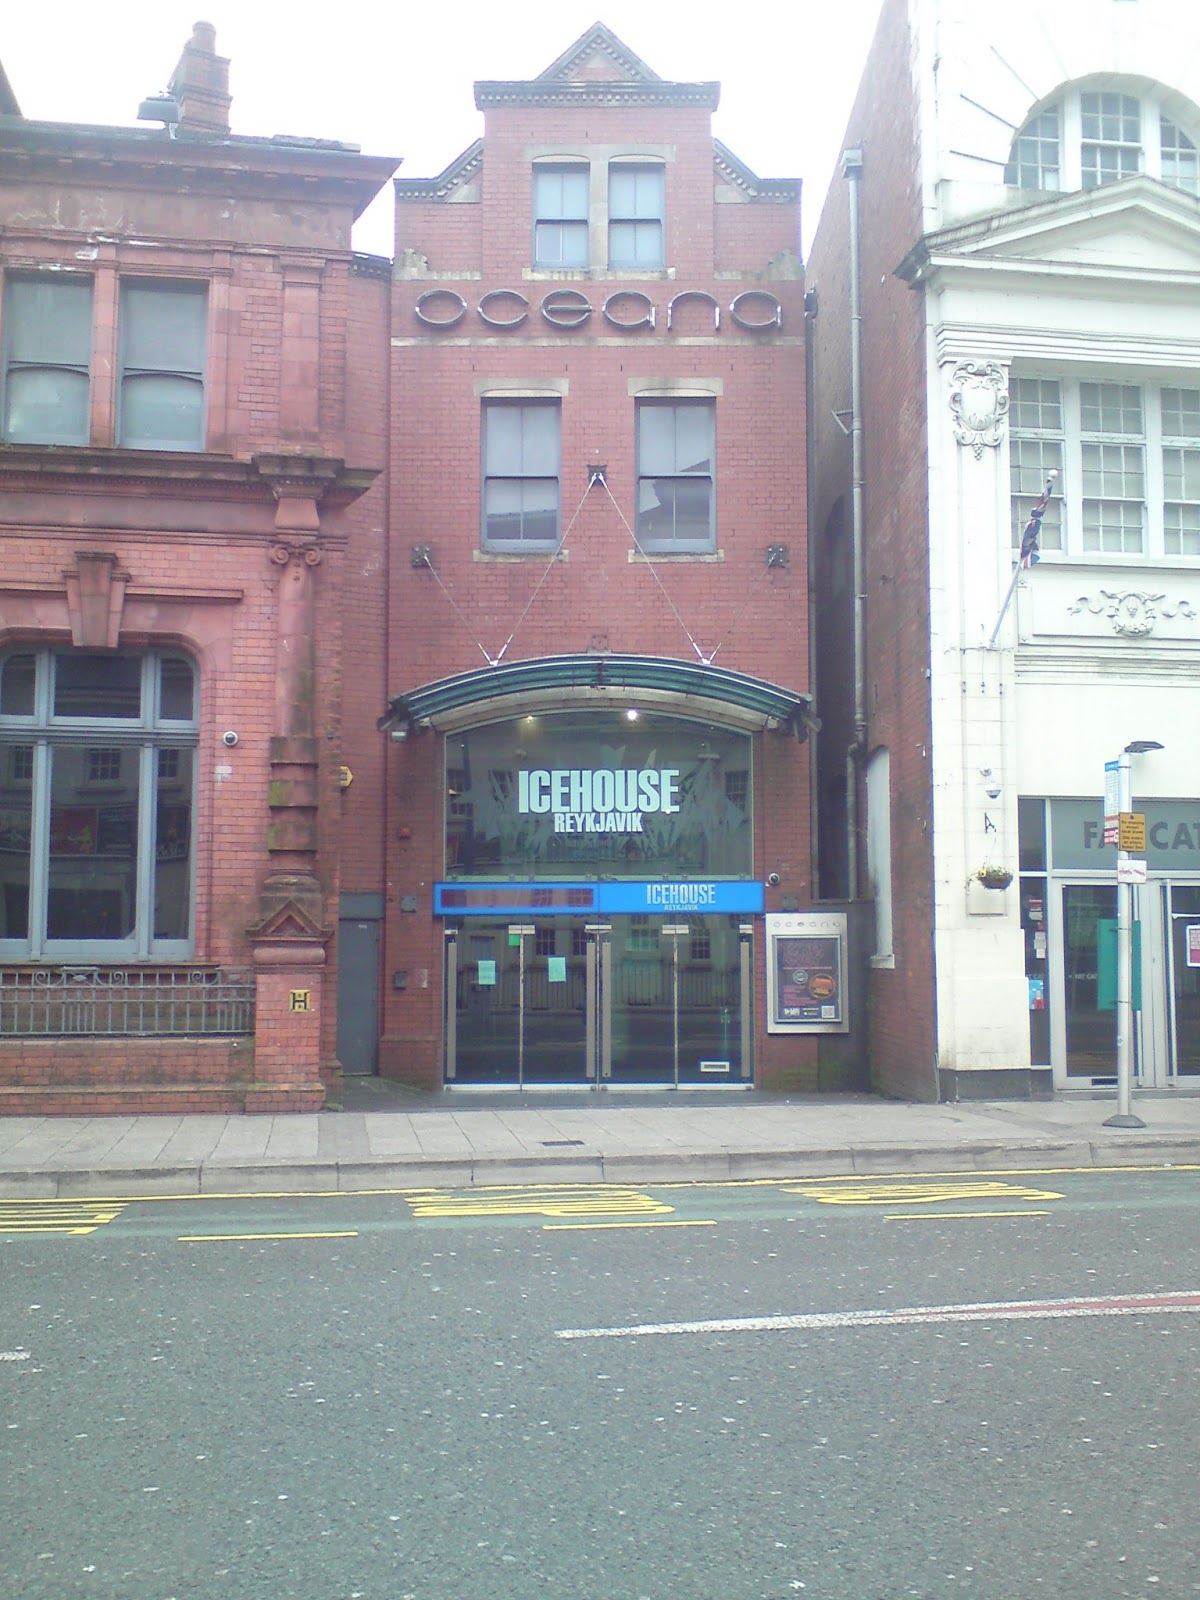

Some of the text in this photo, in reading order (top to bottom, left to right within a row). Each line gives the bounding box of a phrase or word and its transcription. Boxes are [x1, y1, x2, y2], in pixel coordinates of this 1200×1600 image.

[414, 288, 783, 330] oceana
[518, 769, 680, 814] ICEHOUSE
[554, 812, 643, 833] REYKJAVIK
[646, 884, 716, 905] ICEHOUSE
[292, 992, 307, 1010] H
